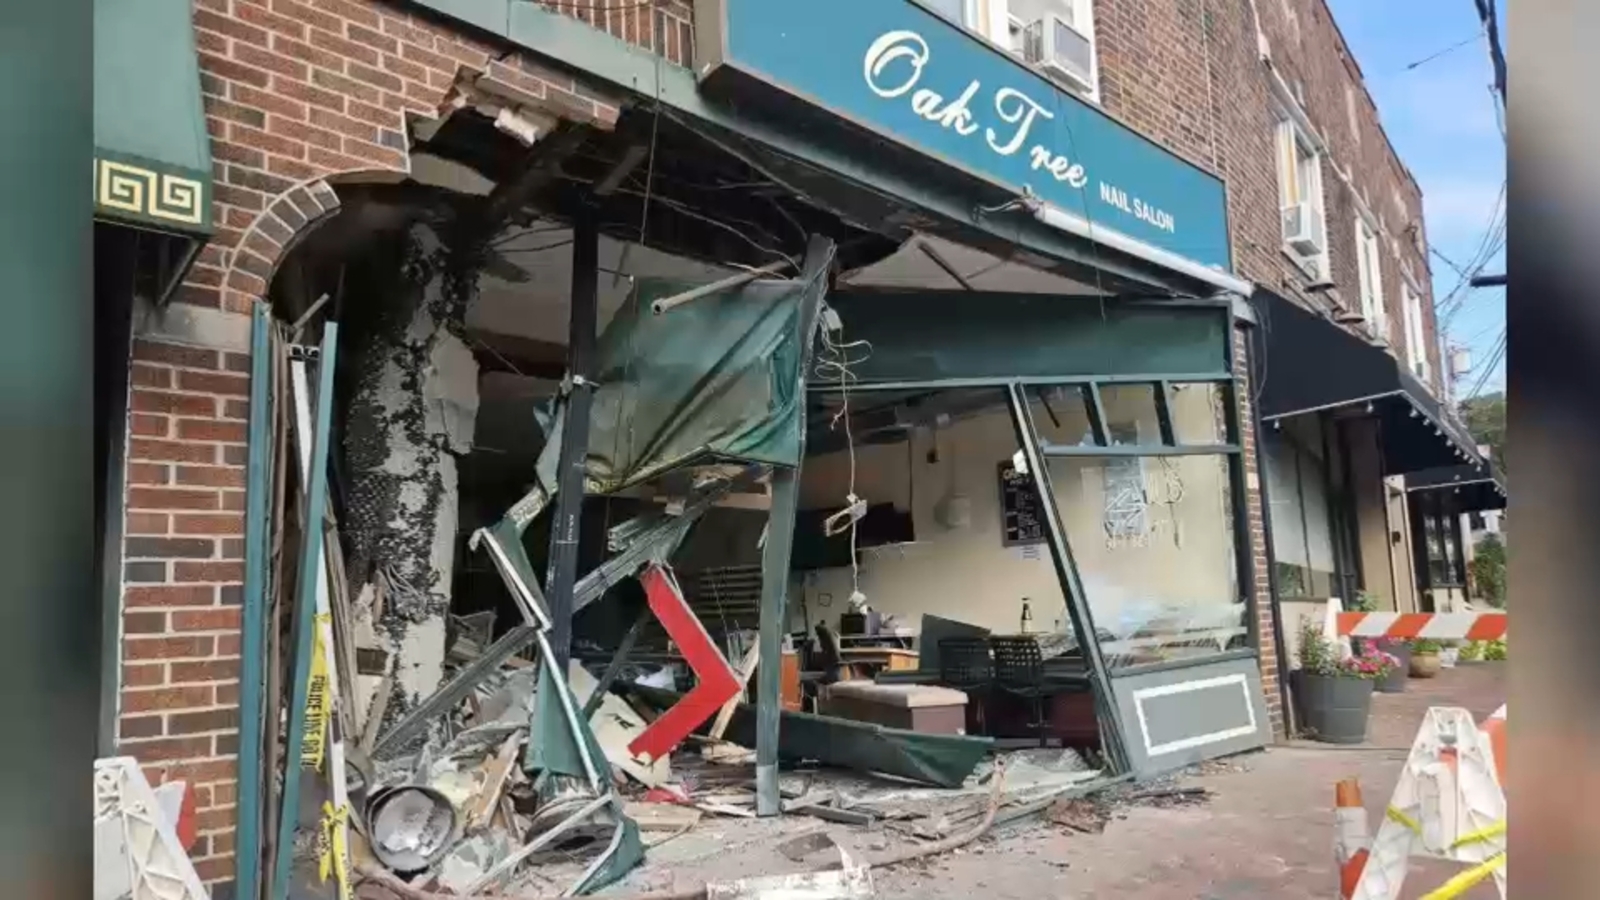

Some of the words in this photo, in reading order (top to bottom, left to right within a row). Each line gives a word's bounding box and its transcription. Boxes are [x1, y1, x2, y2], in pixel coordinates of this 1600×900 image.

[864, 30, 979, 136] Oak
[986, 87, 1088, 189] Tree
[1100, 180, 1132, 214] NAIL
[1133, 196, 1174, 235] SALON
[307, 674, 326, 711] POLICE
[303, 711, 322, 735] LINE
